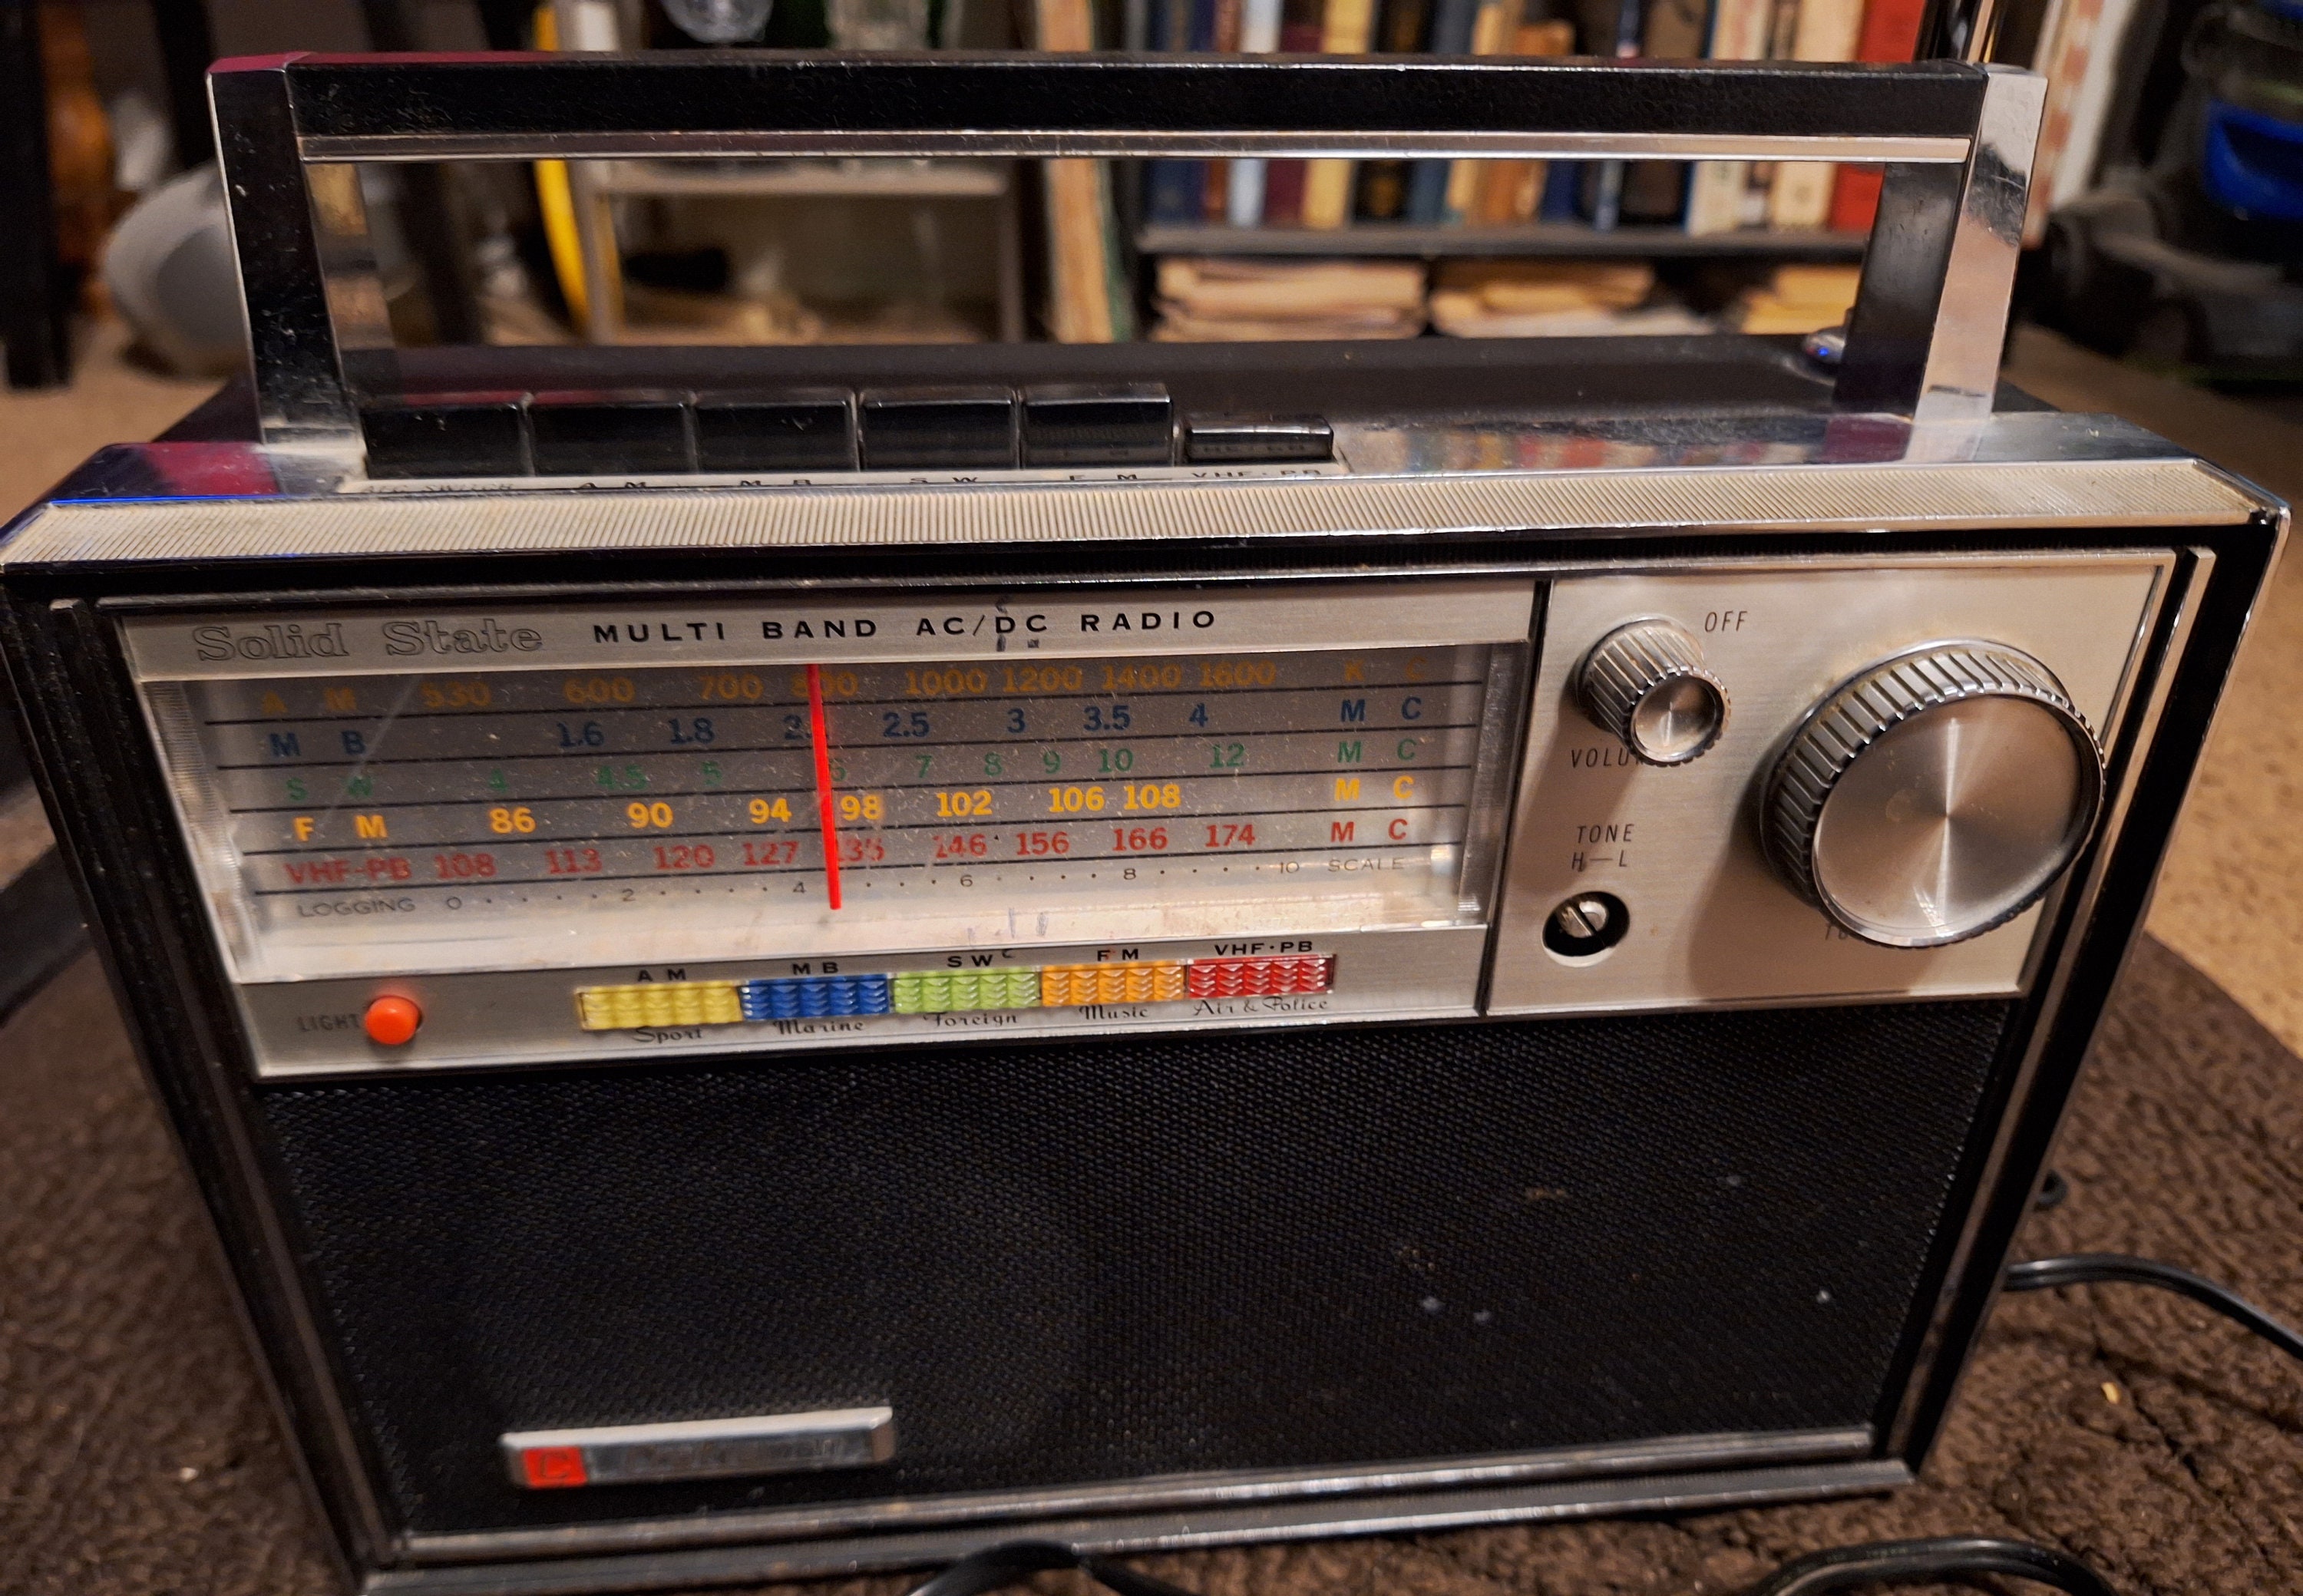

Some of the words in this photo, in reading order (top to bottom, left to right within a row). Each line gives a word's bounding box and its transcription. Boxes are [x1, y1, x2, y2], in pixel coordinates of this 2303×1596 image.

[593, 621, 726, 643] MULTI
[762, 618, 877, 639] BAND
[916, 613, 1049, 637] AC/DC
[1081, 610, 1215, 633] RADIO
[1704, 610, 1748, 633] OFF
[192, 622, 350, 662] Solid
[383, 617, 543, 657] State
[564, 676, 636, 704] 600
[696, 672, 764, 700] 700
[905, 667, 988, 696] 1000
[1003, 666, 1083, 692] 1200
[1102, 663, 1182, 689] 1400
[556, 721, 606, 748] 1.6
[669, 717, 715, 745] 1.8
[783, 713, 828, 741] 2.
[883, 712, 930, 738] 2.5
[1007, 708, 1026, 734] 3
[1083, 705, 1132, 731] 3.5
[1189, 702, 1209, 729] 4
[915, 754, 933, 778] 7
[983, 752, 1003, 776] 8
[1042, 750, 1061, 774] 9
[1098, 748, 1134, 773] 10
[1210, 742, 1247, 768] 12
[487, 808, 536, 834] 86
[626, 801, 674, 829] 90
[748, 798, 792, 824] 94
[841, 795, 884, 821] 98
[936, 790, 993, 818] 102
[1049, 786, 1105, 813] 106
[1124, 783, 1181, 811] 108
[1577, 824, 1634, 844] TONE
[285, 856, 412, 884] VHF-PB
[434, 853, 496, 879] 108
[545, 848, 603, 874] 113
[653, 844, 715, 871] 120
[742, 841, 800, 867] 127
[837, 838, 885, 863] 35
[932, 834, 988, 859] 146
[1016, 831, 1070, 856] 156
[1113, 827, 1168, 852] 166
[1205, 824, 1256, 848] 174
[297, 897, 416, 919] LOGGING
[622, 888, 637, 903] 2
[792, 881, 808, 894] 4
[960, 874, 974, 888] 6
[1123, 867, 1138, 881] 8
[1327, 856, 1406, 874] SCALE
[297, 1006, 361, 1032] LIGHT
[923, 1011, 1019, 1028] Foreign
[1079, 1004, 1149, 1021] Music
[1194, 1000, 1234, 1016] Air
[1244, 1000, 1258, 1013] &
[1262, 996, 1329, 1013] Police
[633, 1026, 705, 1045] Sport
[772, 1019, 865, 1036] Marine
